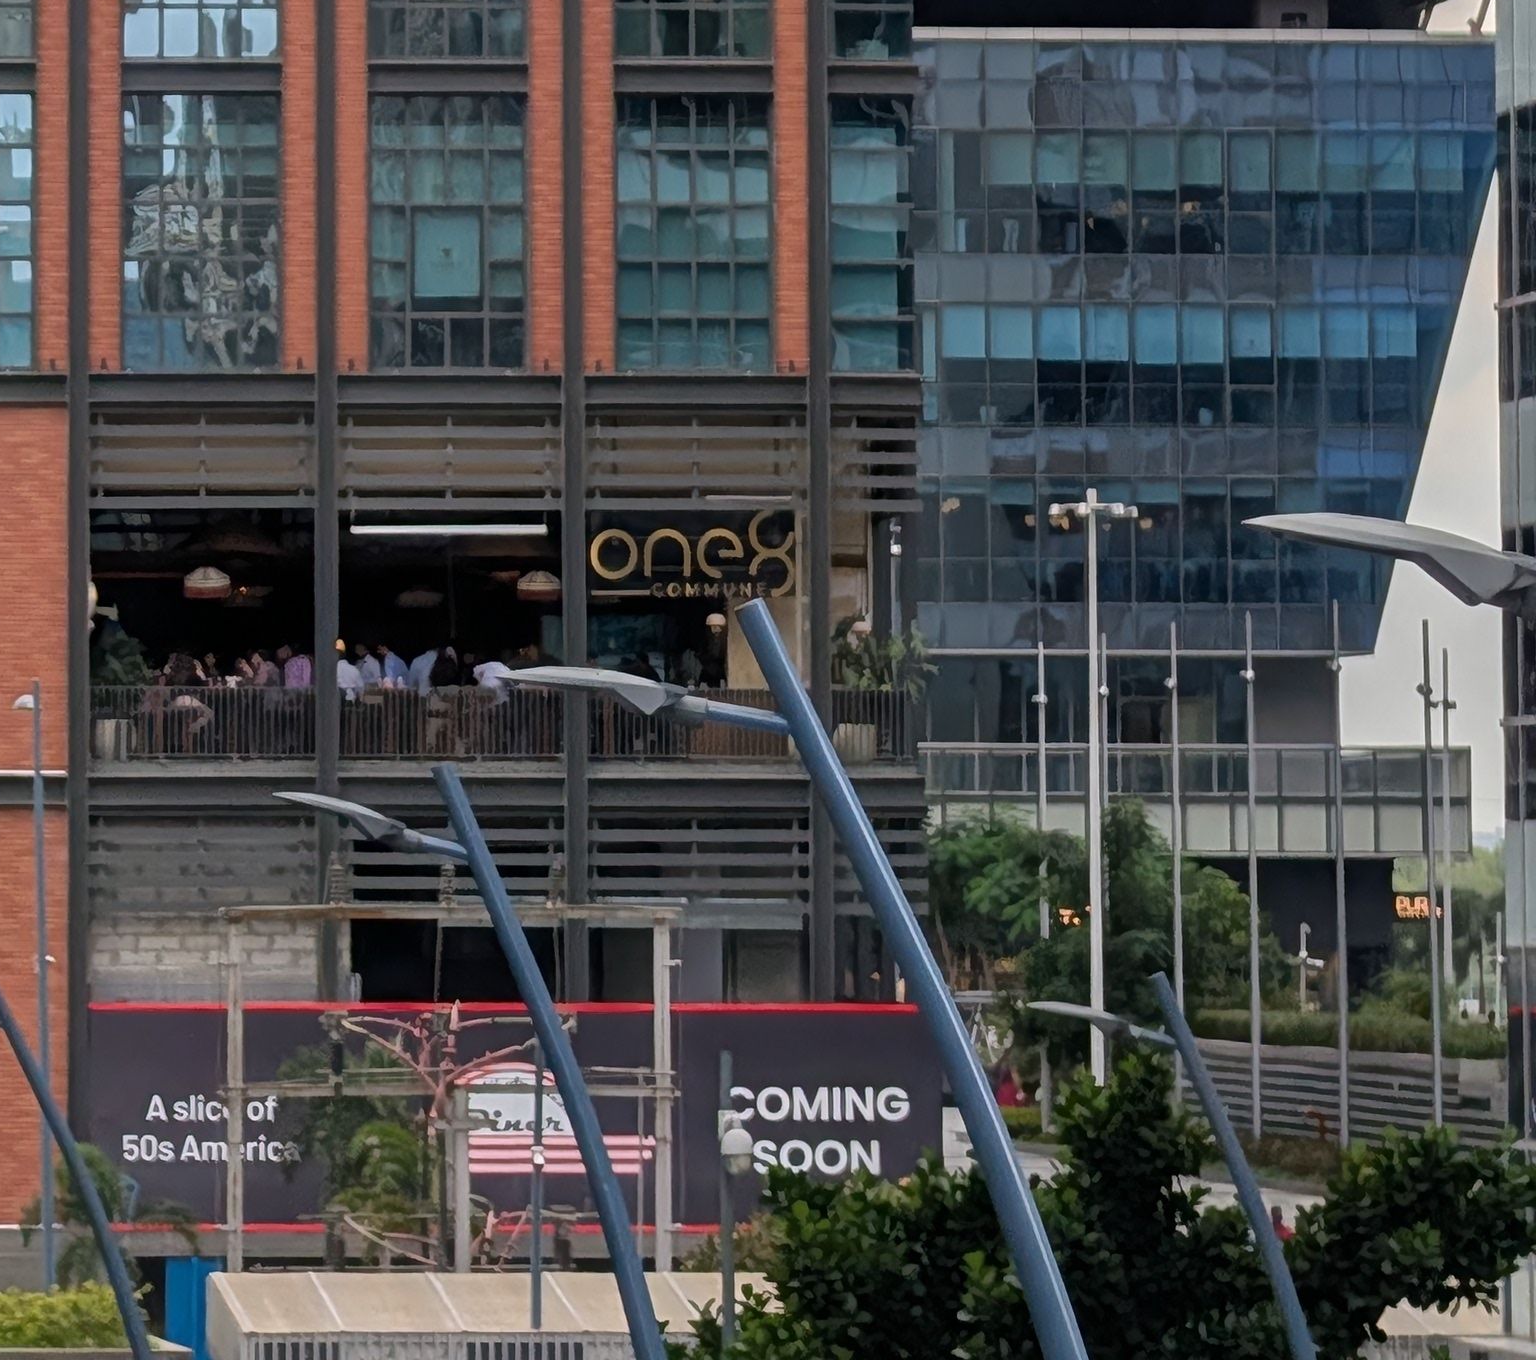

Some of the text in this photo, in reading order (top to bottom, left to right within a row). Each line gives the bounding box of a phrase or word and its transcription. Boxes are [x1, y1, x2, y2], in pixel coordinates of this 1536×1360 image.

[590, 510, 797, 597] one8
[651, 582, 767, 598] COMMUNE
[146, 1094, 169, 1122] A
[246, 1094, 279, 1124] of
[730, 1086, 911, 1123] COMING
[122, 1133, 303, 1164] 50s Amrica
[752, 1139, 882, 1176] SOON
